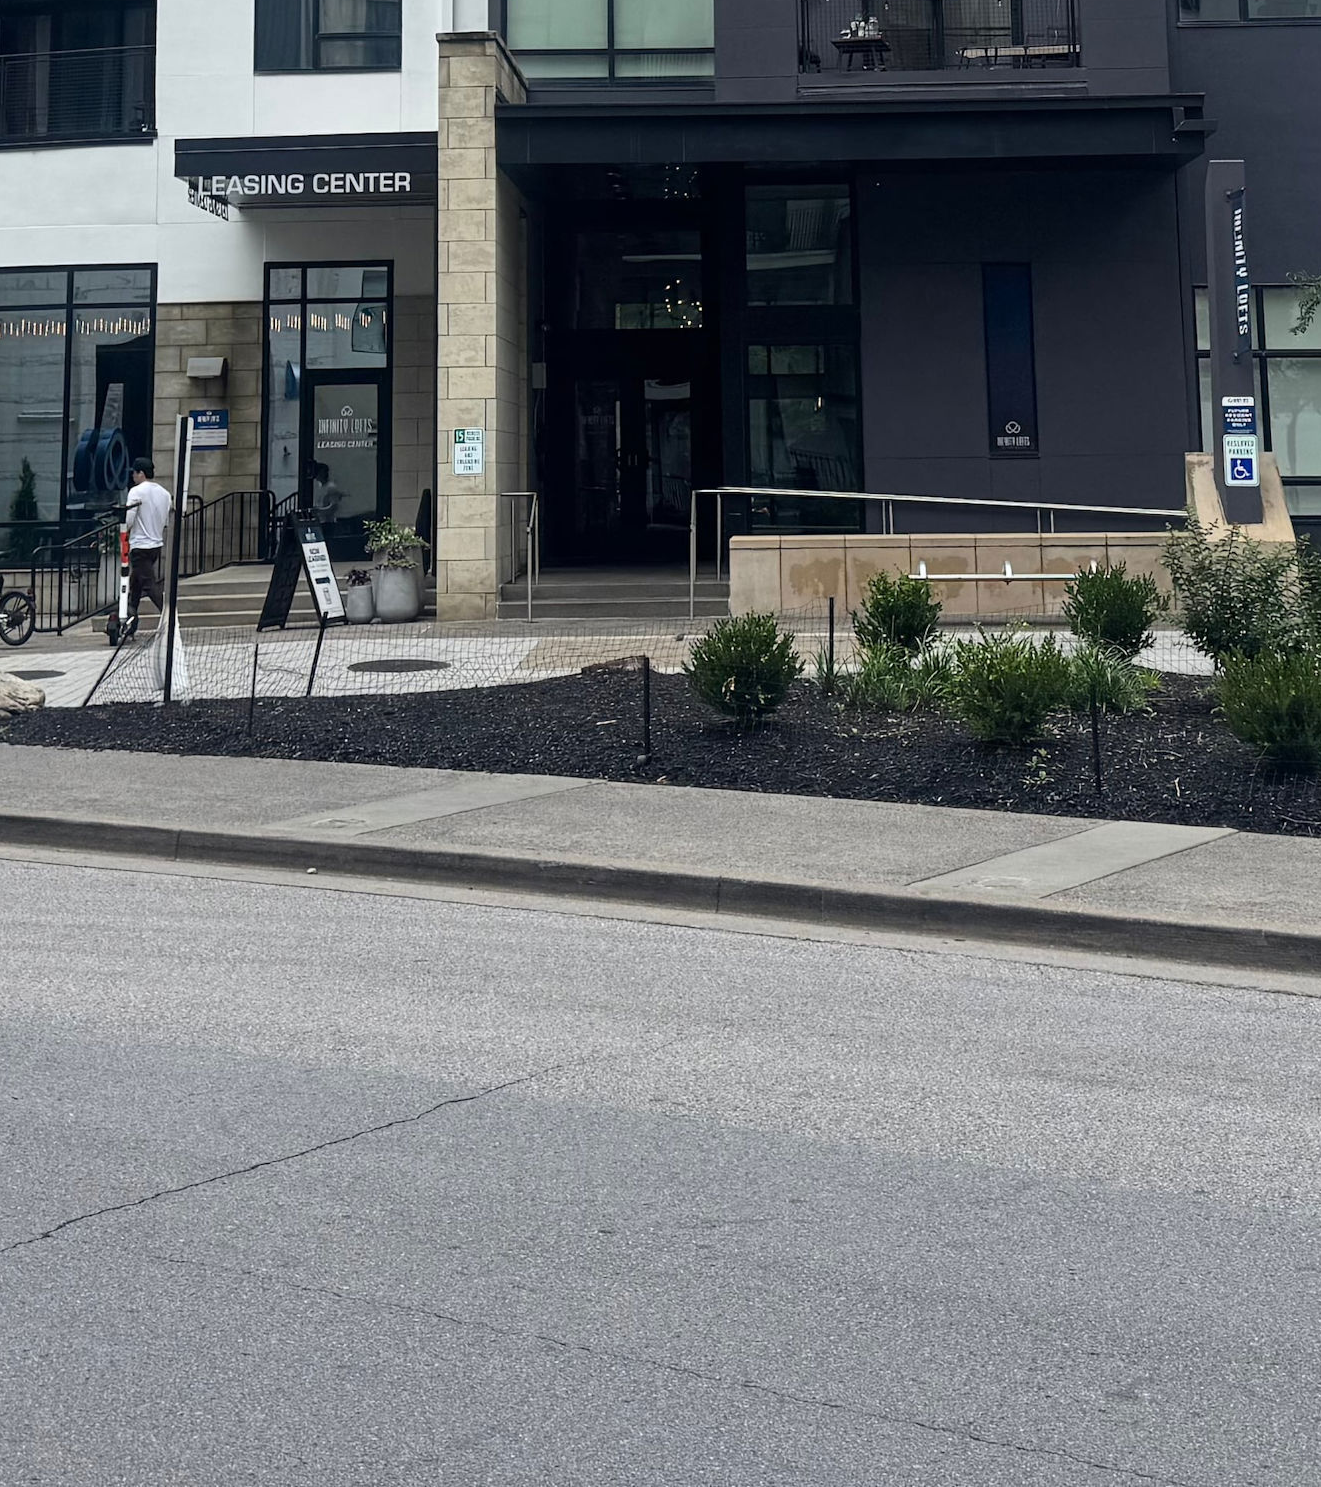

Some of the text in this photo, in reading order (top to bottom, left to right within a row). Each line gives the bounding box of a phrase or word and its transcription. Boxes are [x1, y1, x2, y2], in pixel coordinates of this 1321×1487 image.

[197, 172, 412, 196] LEASING CENTER
[1233, 208, 1249, 335] INFINITY LOFTS
[318, 418, 373, 434] INFINITY LOFTS
[455, 430, 464, 443] 15
